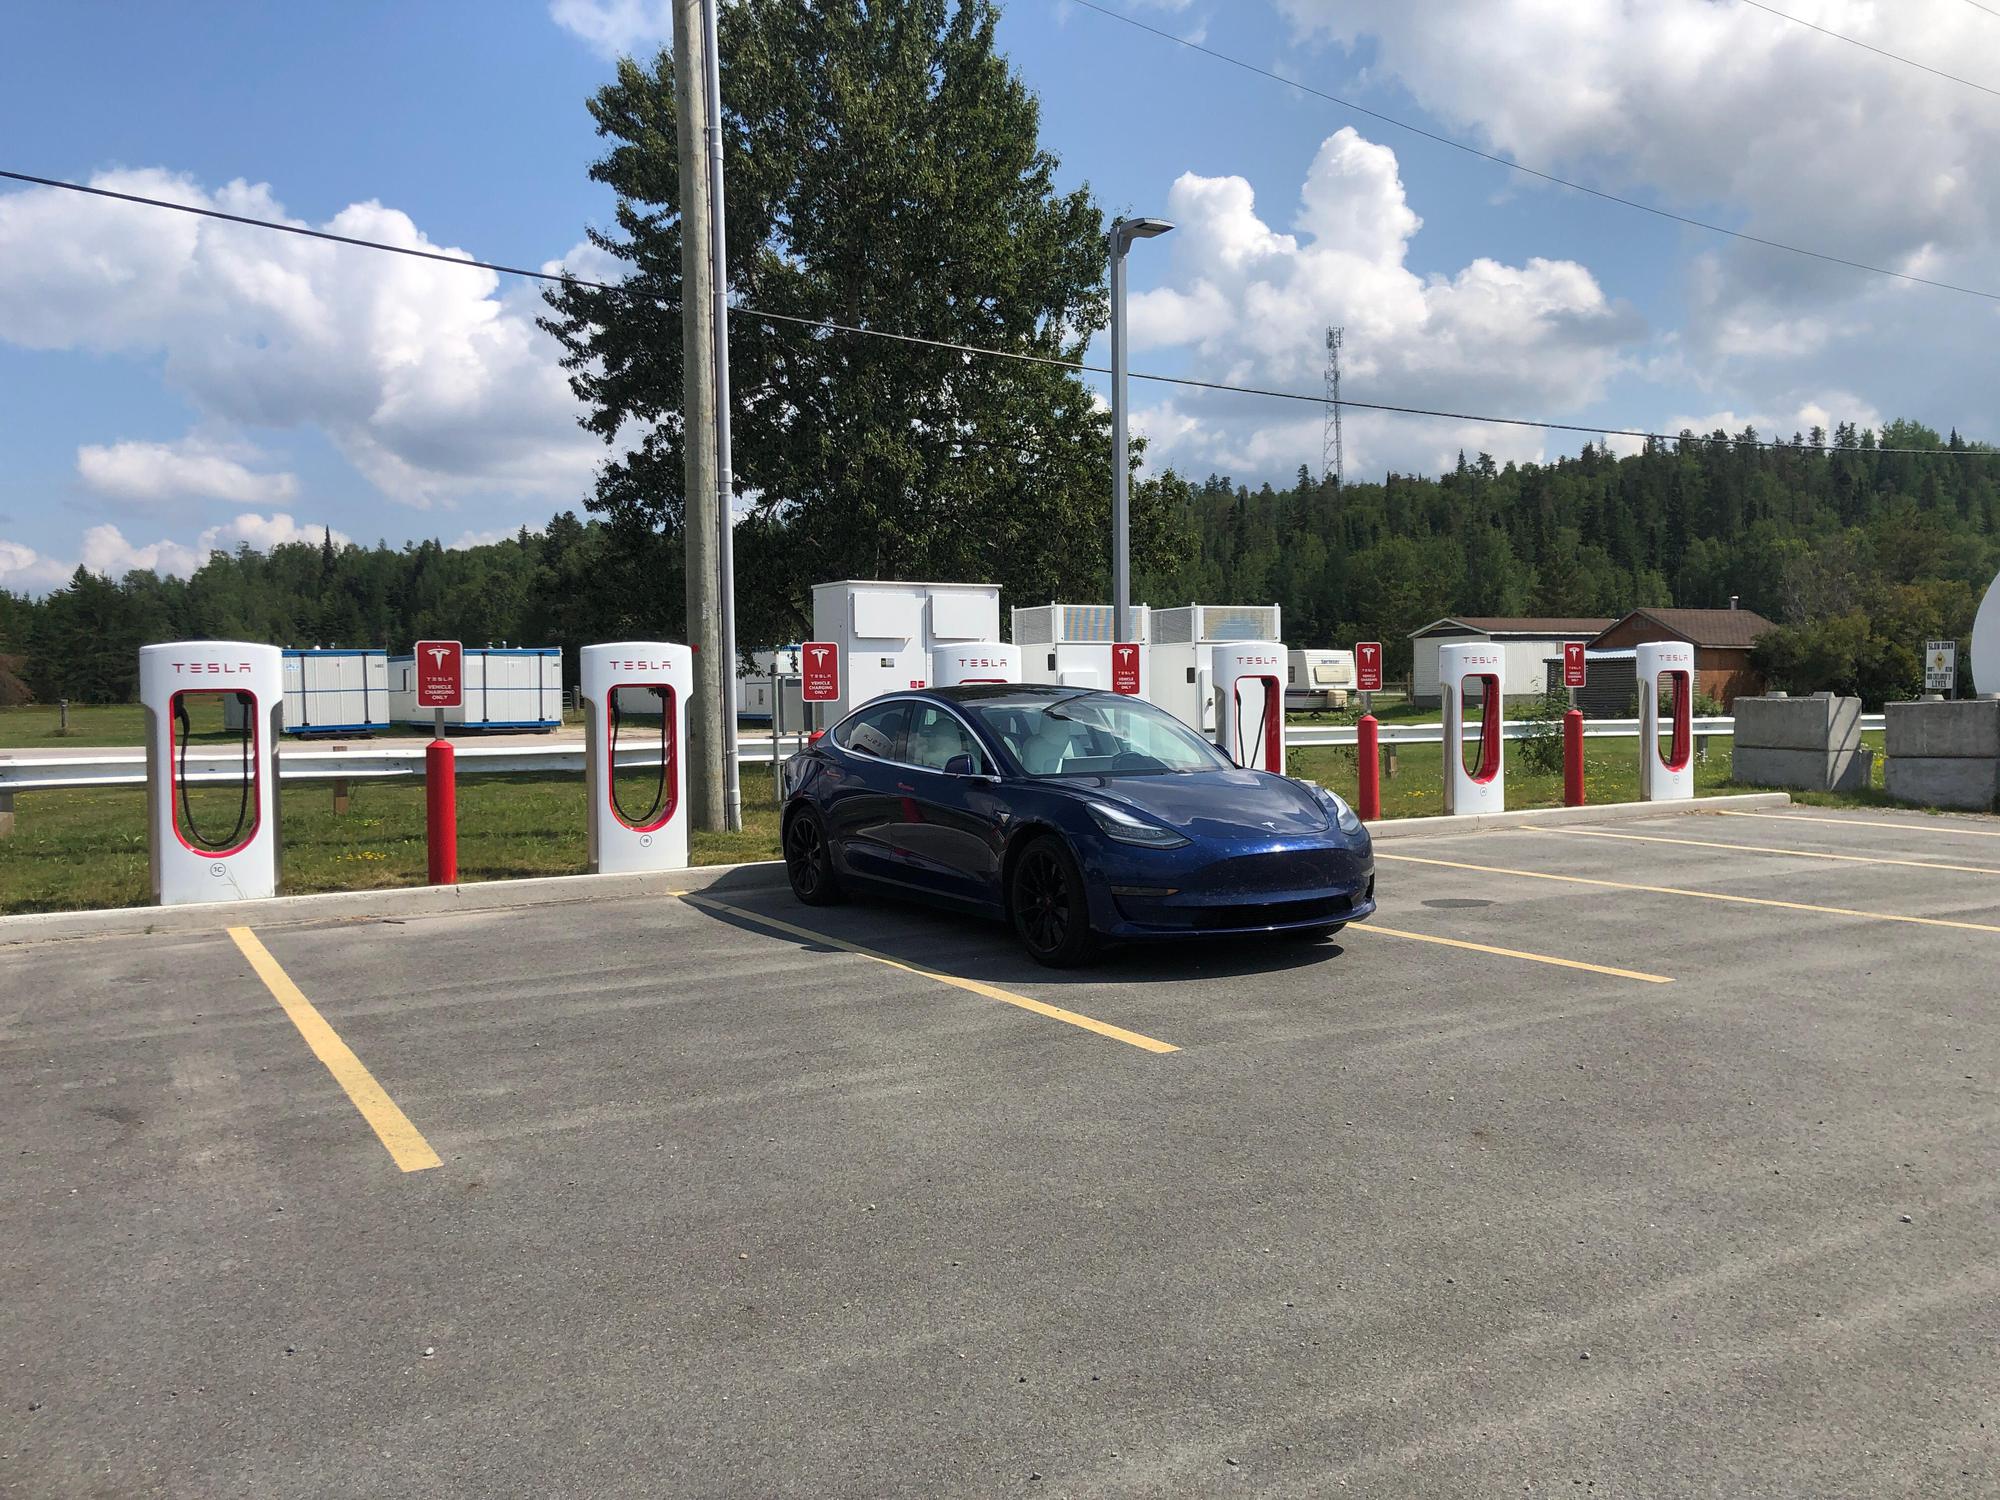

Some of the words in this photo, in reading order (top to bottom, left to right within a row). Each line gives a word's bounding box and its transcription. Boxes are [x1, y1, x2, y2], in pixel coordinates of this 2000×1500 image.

[1236, 656, 1278, 665] TESLA
[1463, 656, 1498, 664] TESLA
[1658, 654, 1688, 662] TESLA
[609, 660, 672, 671] TESLA
[958, 658, 1007, 668] TESLA
[171, 663, 251, 674] TESLA
